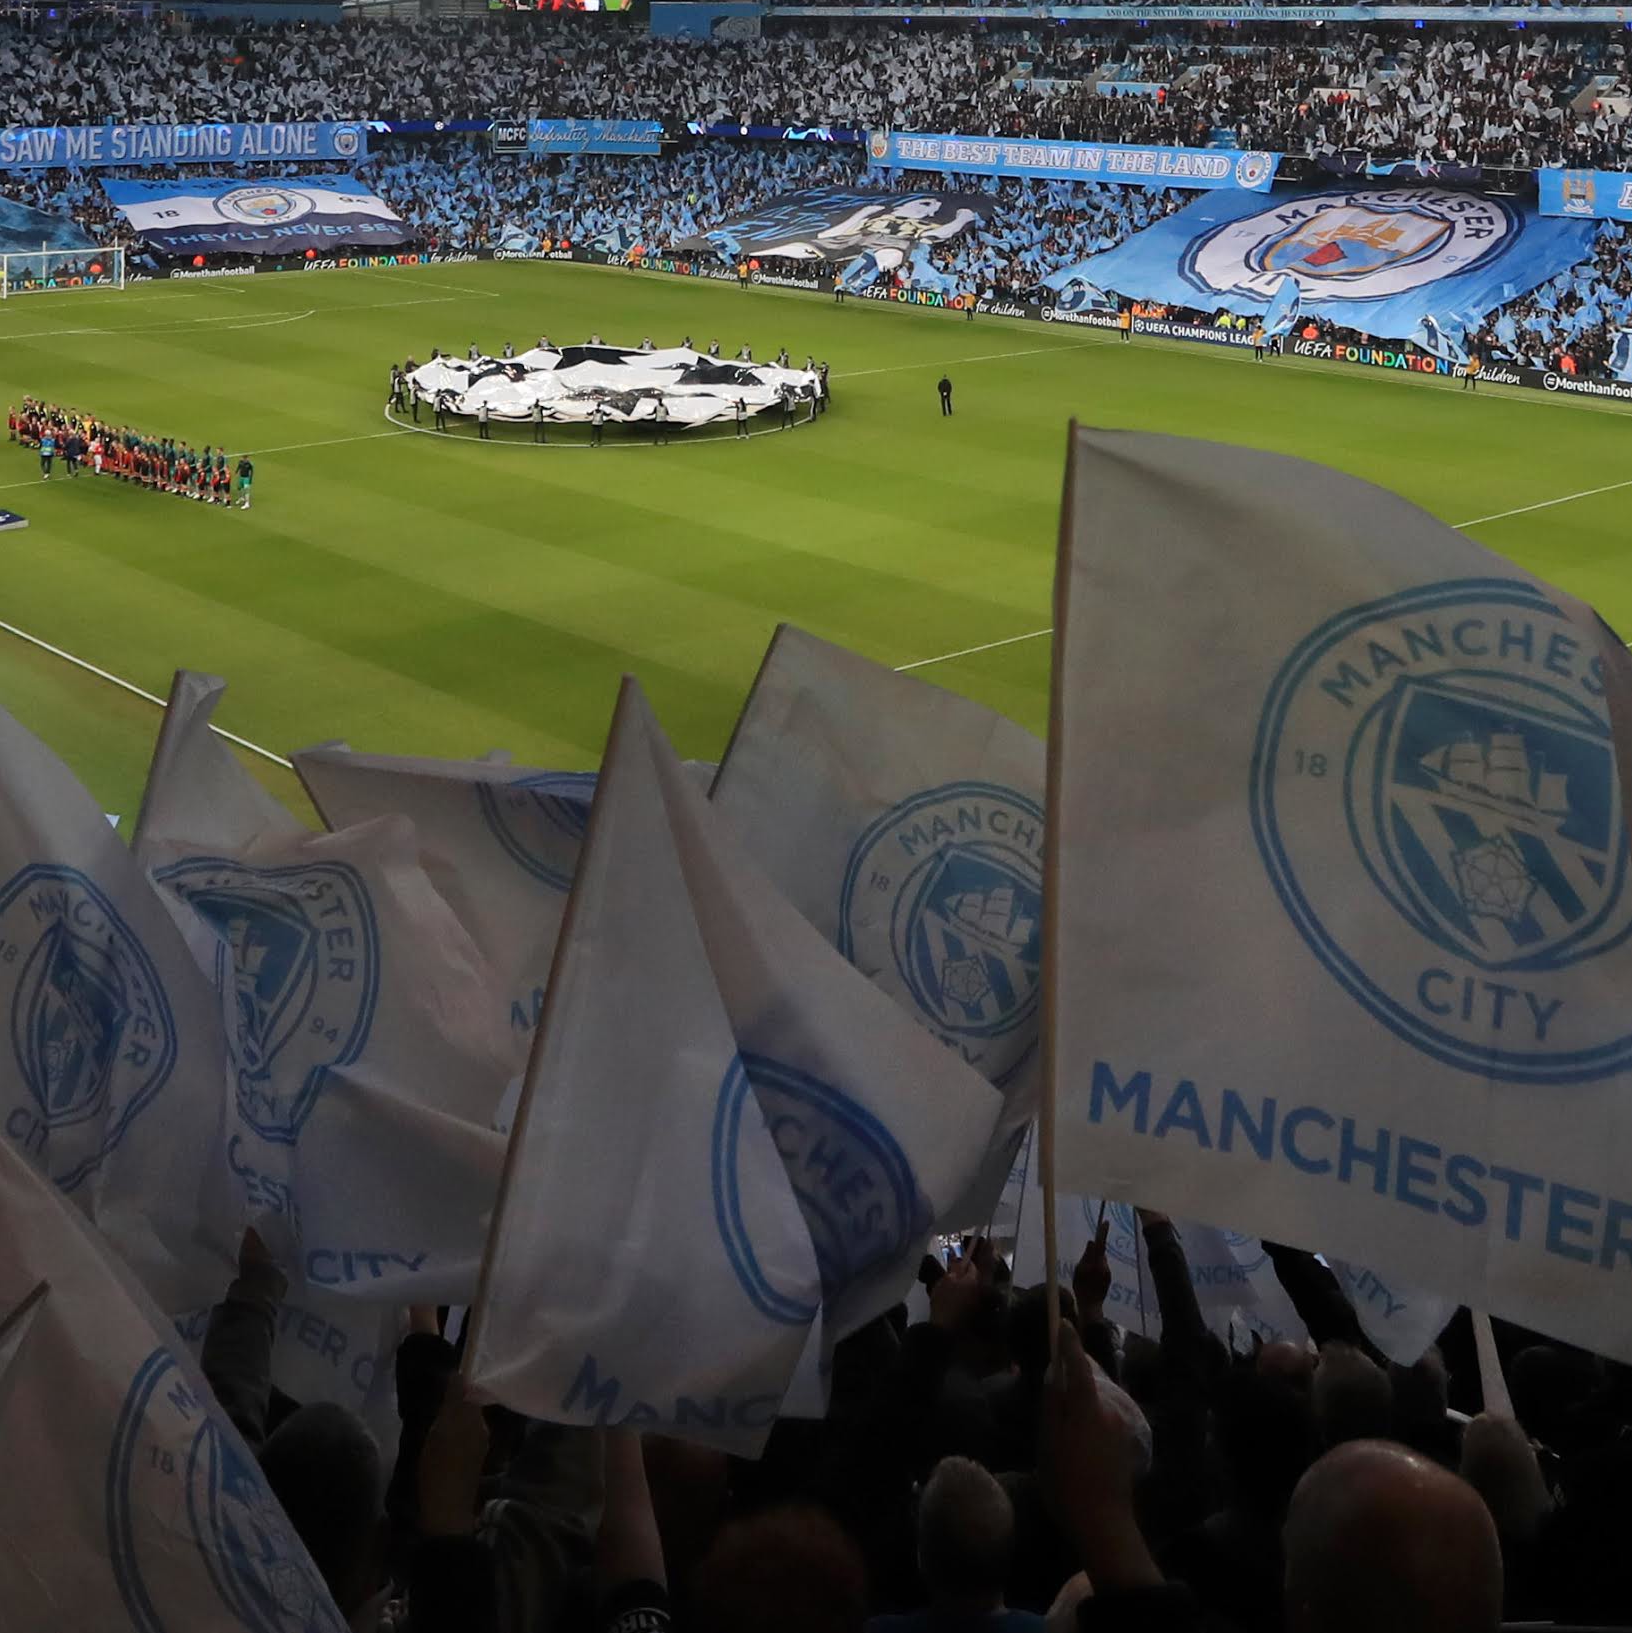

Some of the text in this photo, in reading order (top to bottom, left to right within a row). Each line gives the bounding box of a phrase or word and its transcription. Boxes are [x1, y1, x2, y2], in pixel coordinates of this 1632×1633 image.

[0, 129, 57, 162] SAW
[66, 128, 103, 160] ME
[111, 126, 231, 159] STANDING
[239, 124, 318, 155] ALONE
[498, 127, 527, 142] MCFC
[896, 138, 941, 161] THE
[942, 140, 998, 165] BEST
[1002, 144, 1072, 169] TEAM
[1073, 147, 1101, 171] IN
[1107, 149, 1157, 175] THE
[1158, 152, 1230, 179] LAND
[152, 208, 181, 219] 18
[1275, 189, 1495, 239] MACHESTER
[167, 231, 269, 246] THEY'LL
[273, 220, 355, 239] NEVER
[303, 250, 478, 271] UEFA FOUNDATION for children
[503, 249, 573, 260] Morehanfotball
[634, 256, 699, 276] FOUNDATION
[709, 266, 738, 281] children
[180, 264, 254, 279] Morethanfootball
[758, 274, 818, 289] Morethanfootball
[889, 287, 969, 311] FOUNDATO
[976, 299, 989, 313] for
[990, 301, 1026, 317] children
[1146, 322, 1170, 335] UEFA
[1172, 324, 1227, 342] CHAMPIONS
[1294, 339, 1332, 358] UEFA
[1335, 343, 1447, 374] FOUNDATION
[1474, 366, 1521, 385] children
[1320, 617, 1607, 709] MANCHES
[1293, 748, 1328, 778] 18
[896, 805, 1038, 858] MANCH
[869, 870, 891, 894] 18
[1417, 968, 1565, 1042] CITY
[309, 1016, 338, 1044] 94
[305, 1247, 427, 1286] CITY
